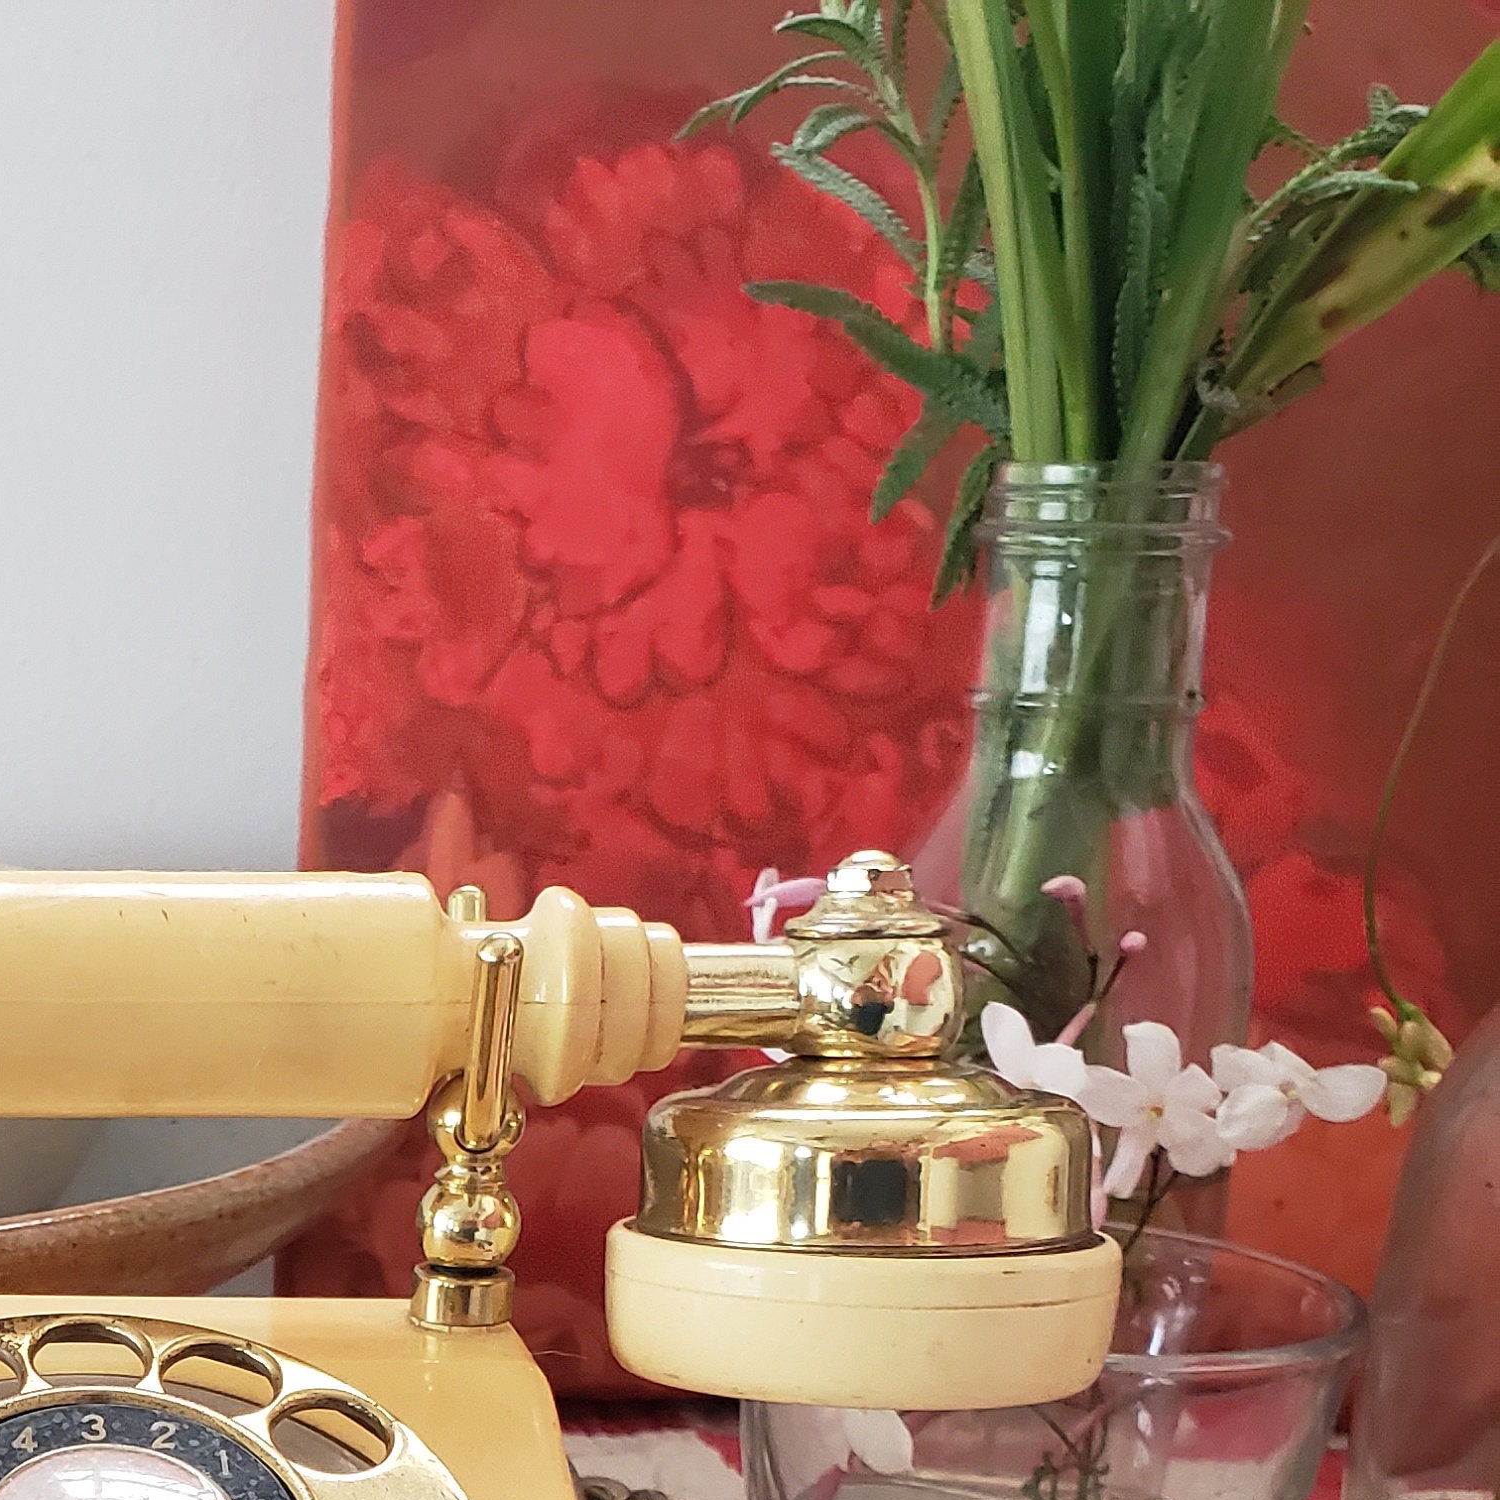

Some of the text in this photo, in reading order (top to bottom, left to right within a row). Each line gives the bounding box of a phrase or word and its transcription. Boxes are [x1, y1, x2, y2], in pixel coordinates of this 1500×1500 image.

[11, 1426, 38, 1454] 4
[80, 1413, 107, 1441] 3
[149, 1420, 179, 1450] 2
[215, 1449, 232, 1476] 1
